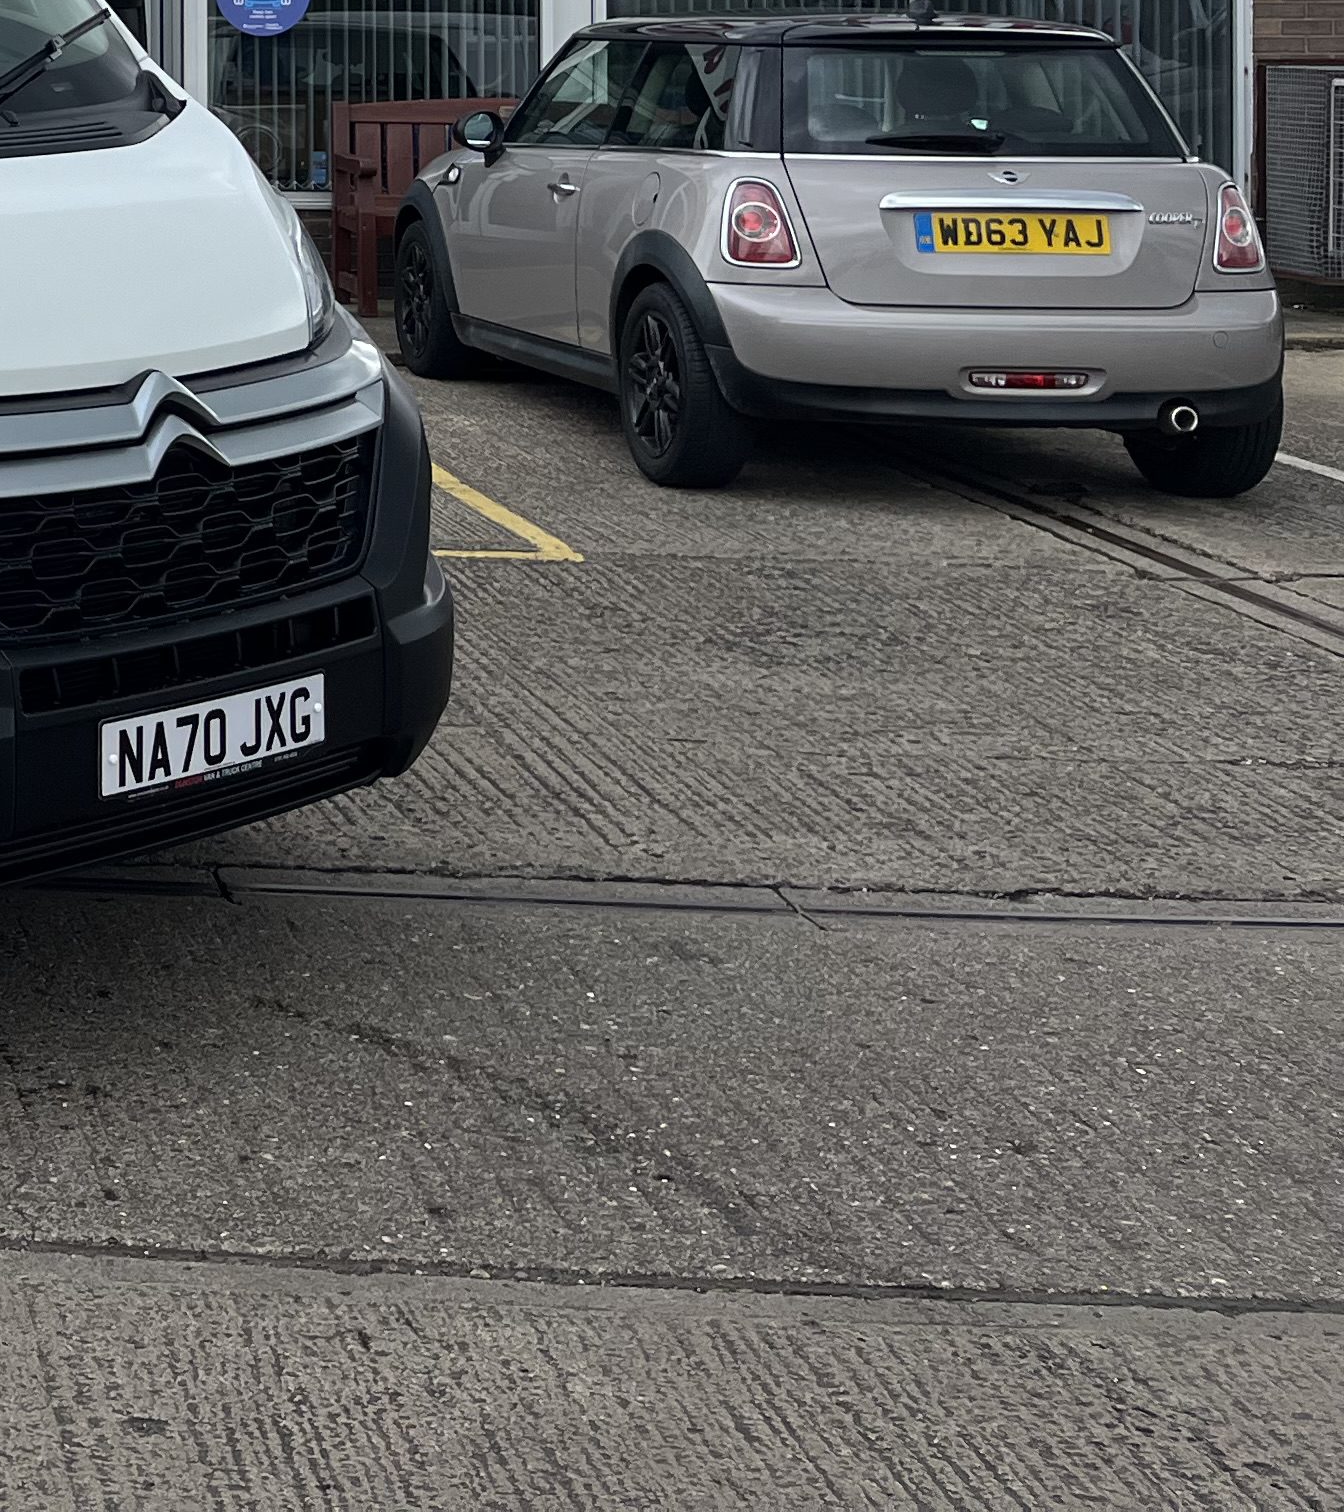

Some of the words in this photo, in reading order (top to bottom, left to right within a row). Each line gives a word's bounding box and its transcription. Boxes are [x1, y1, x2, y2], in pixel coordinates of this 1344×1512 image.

[938, 217, 1028, 247] WD63
[1037, 218, 1106, 248] YAJ
[1149, 212, 1193, 224] COOPER
[119, 708, 226, 788] NA70
[240, 686, 311, 758] JXG
